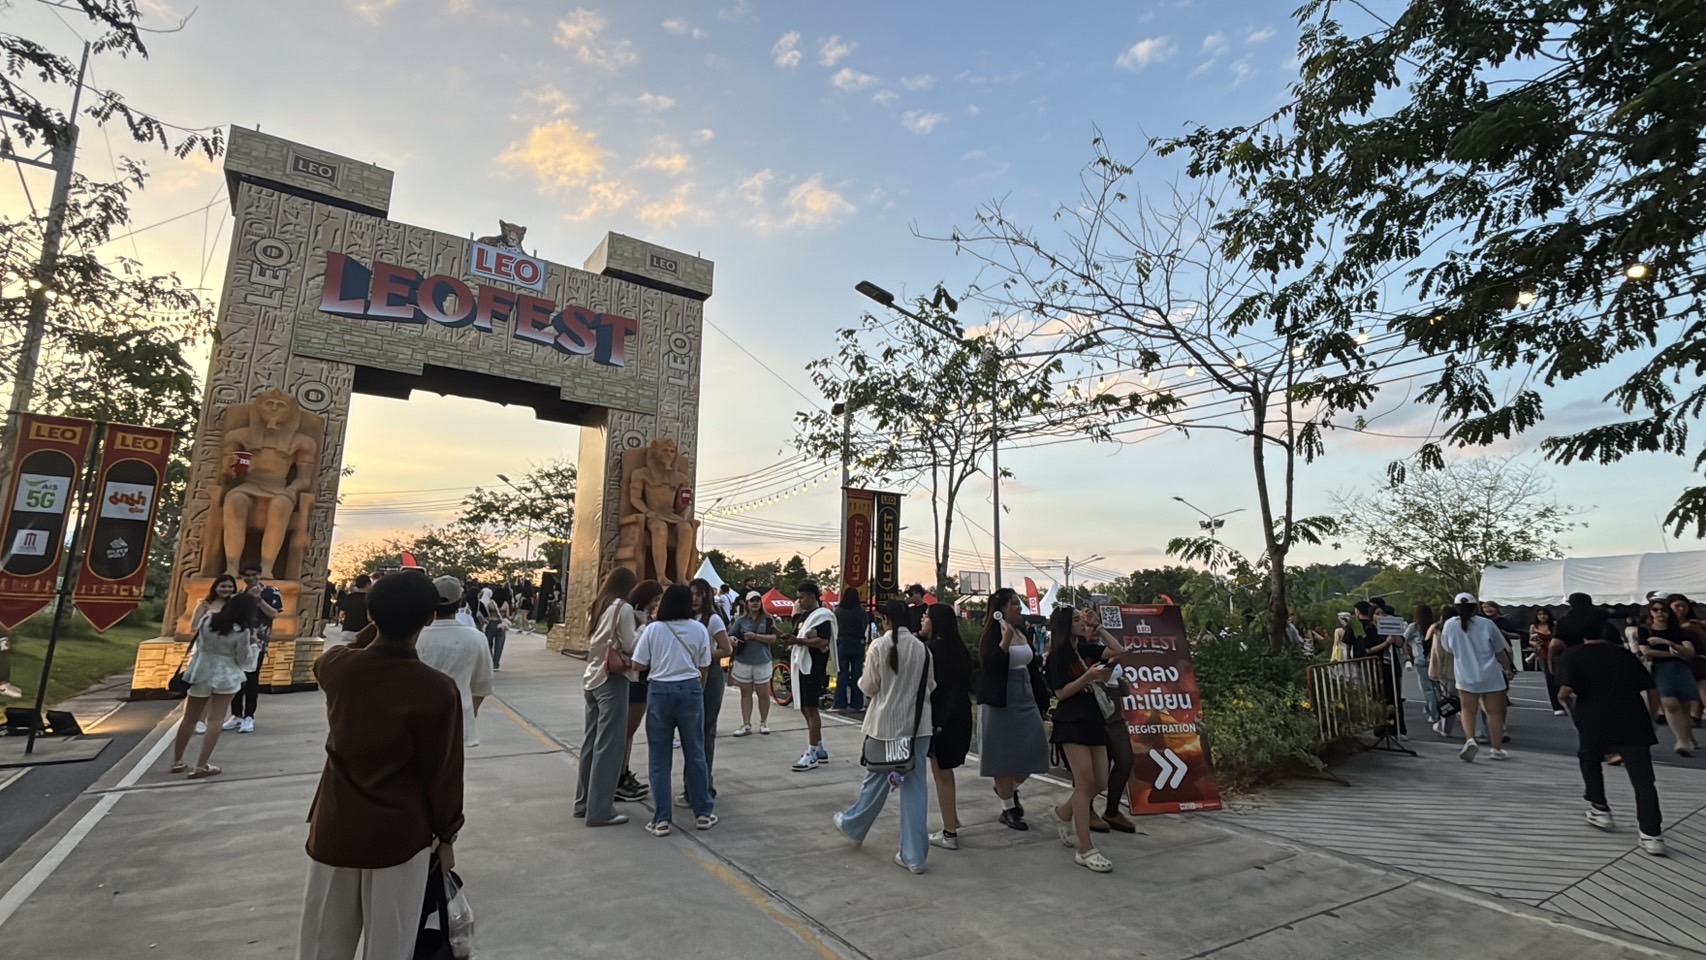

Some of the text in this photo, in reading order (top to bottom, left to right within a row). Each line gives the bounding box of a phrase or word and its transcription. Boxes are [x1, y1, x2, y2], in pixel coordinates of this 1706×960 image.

[298, 160, 332, 177] LEO
[245, 237, 292, 308] LEO
[475, 247, 540, 284] LEO
[653, 257, 676, 271] LEO
[318, 250, 638, 367] LEOFEST
[667, 331, 690, 387] LEO
[35, 425, 77, 441] LEO
[120, 435, 159, 450] LEO
[25, 490, 56, 508] 5G
[852, 520, 864, 580] LEOFEST
[883, 512, 894, 582] LEOFEST
[1123, 635, 1177, 651] EOFEST
[1123, 688, 1192, 710] ทะเบียน
[1128, 722, 1196, 734] REGISTRATION
